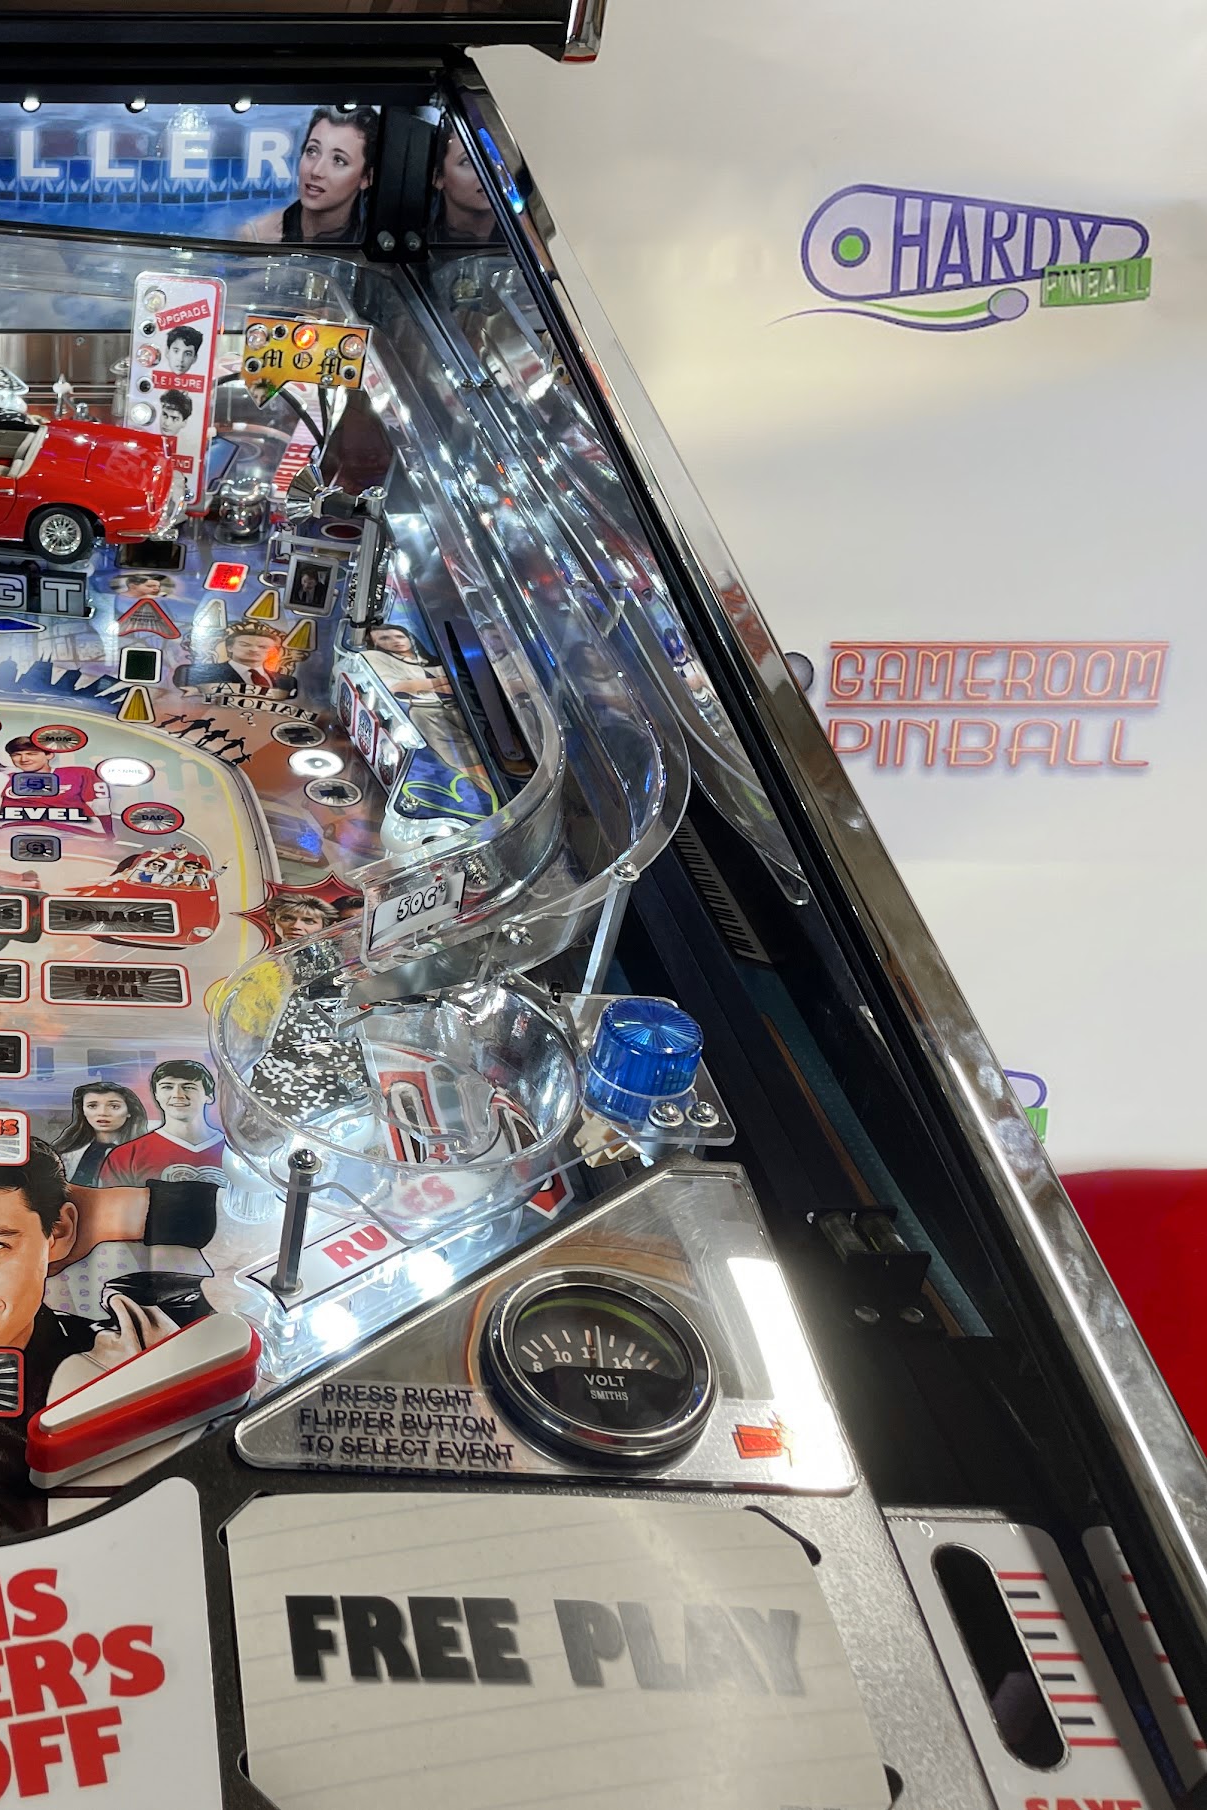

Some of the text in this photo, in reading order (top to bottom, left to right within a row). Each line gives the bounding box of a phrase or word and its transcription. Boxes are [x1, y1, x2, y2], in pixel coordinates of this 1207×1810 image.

[894, 195, 1099, 293] HARDY
[1045, 265, 1150, 300] PINBALL
[156, 303, 209, 328] UPGRADE
[262, 348, 342, 376] MOM
[153, 375, 203, 390] LEISURE
[829, 649, 1165, 700] GAMEROOM
[827, 718, 1149, 767] PINBALL
[93, 782, 110, 799] 9
[142, 813, 164, 822] DAD
[27, 842, 44, 854] 6
[65, 909, 156, 923] PARADE
[74, 968, 153, 984] PHONY
[85, 984, 144, 998] CALL
[532, 1361, 544, 1373] 8
[553, 1350, 633, 1370] 10 14
[584, 1374, 626, 1387] VOLT
[322, 1384, 474, 1409] PRESS RIGHT
[590, 1389, 629, 1401] SMITHS
[299, 1408, 498, 1435] FLIPPER BUTTON
[301, 1434, 516, 1462] TO SELECT EVENT
[284, 1594, 807, 1696] FREE PLAY
